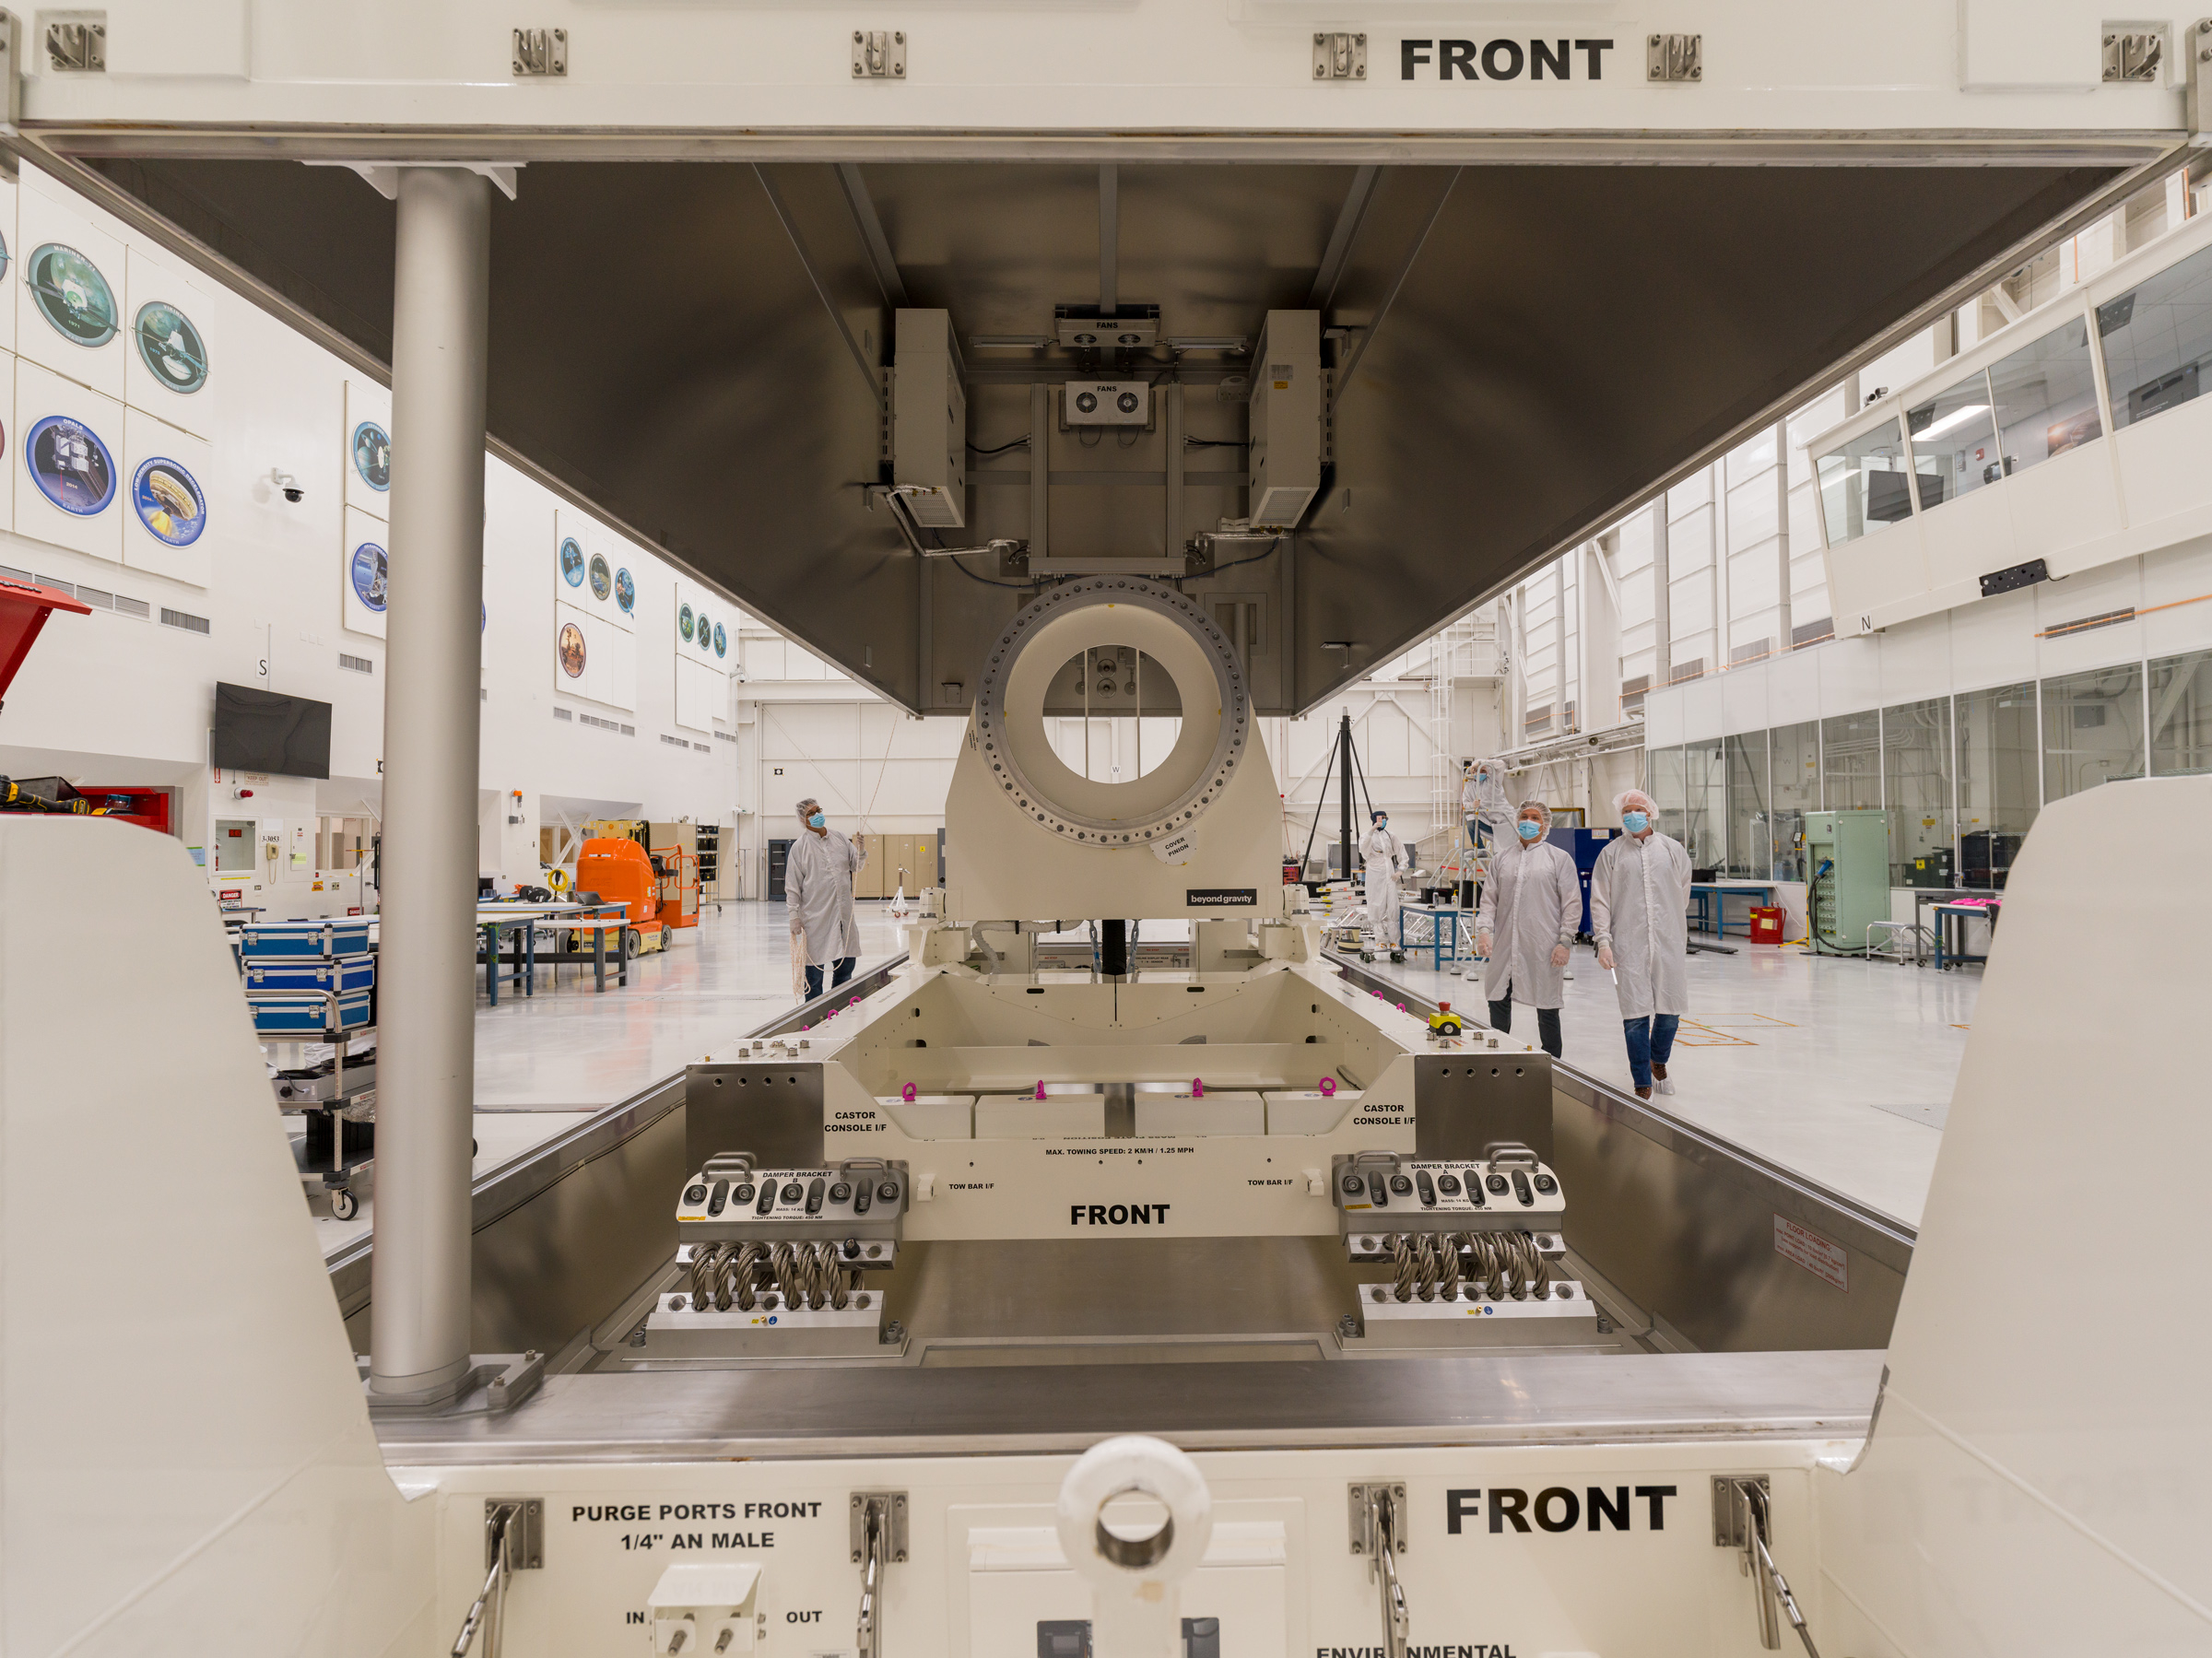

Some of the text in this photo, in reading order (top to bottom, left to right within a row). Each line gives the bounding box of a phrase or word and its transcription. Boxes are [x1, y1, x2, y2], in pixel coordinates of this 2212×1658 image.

[1401, 39, 1614, 81] FRONT
[163, 305, 184, 319] VIKING
[63, 418, 84, 430] OPALS
[153, 459, 186, 476] SUPERSONIC
[185, 473, 206, 515] DECELERATOR
[1862, 616, 1871, 630] N
[259, 659, 267, 676] S
[1165, 837, 1185, 850] COVER
[1168, 843, 1189, 857] PINION
[1191, 890, 1253, 904] beyond gravity
[1070, 1204, 1171, 1225] FRONT
[1784, 1231, 1794, 1241] POINT
[1795, 1238, 1805, 1247] LOAD
[1787, 1222, 1832, 1252] FLOOR LOADING:
[1785, 1249, 1794, 1258] AREA
[1795, 1254, 1805, 1264] LOAD
[572, 1502, 822, 1522] PURGE PORTS FRONT
[1446, 1485, 1677, 1535] FRONT
[620, 1532, 775, 1550] 1/4" AN MALE
[626, 1612, 644, 1624] IN
[786, 1610, 823, 1623] OUT
[1316, 1644, 1517, 1658] ENVIRNMENTAL
